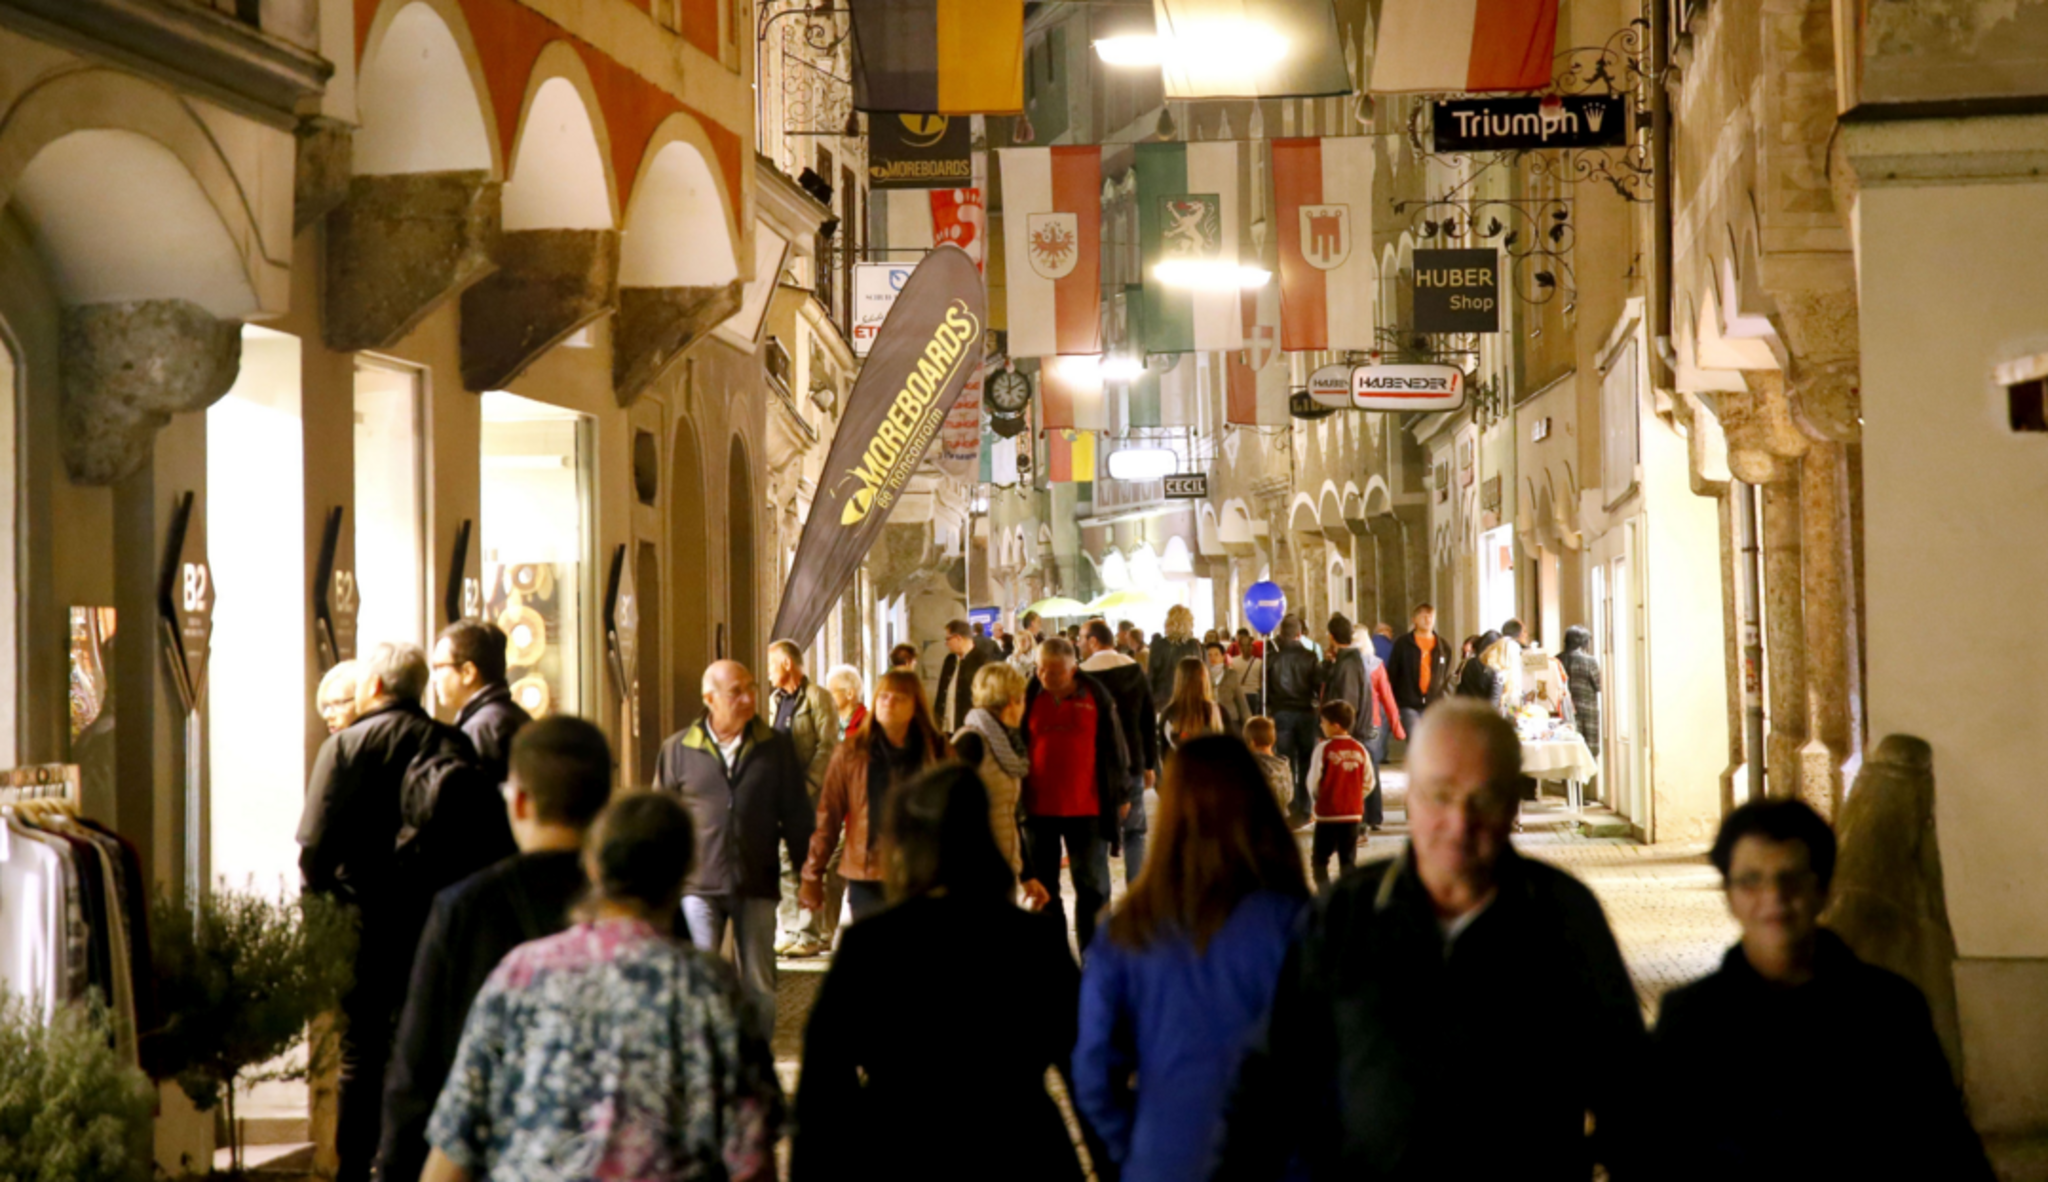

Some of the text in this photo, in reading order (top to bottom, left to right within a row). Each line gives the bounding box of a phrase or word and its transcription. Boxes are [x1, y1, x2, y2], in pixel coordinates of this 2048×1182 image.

[1452, 108, 1578, 142] Triumph
[888, 160, 969, 177] MOREBOARDS
[1416, 268, 1494, 287] HUBER
[1450, 294, 1494, 312] Shop
[855, 306, 972, 495] MOREBOARDS
[1166, 481, 1205, 492] CECIL
[183, 562, 207, 612] B2
